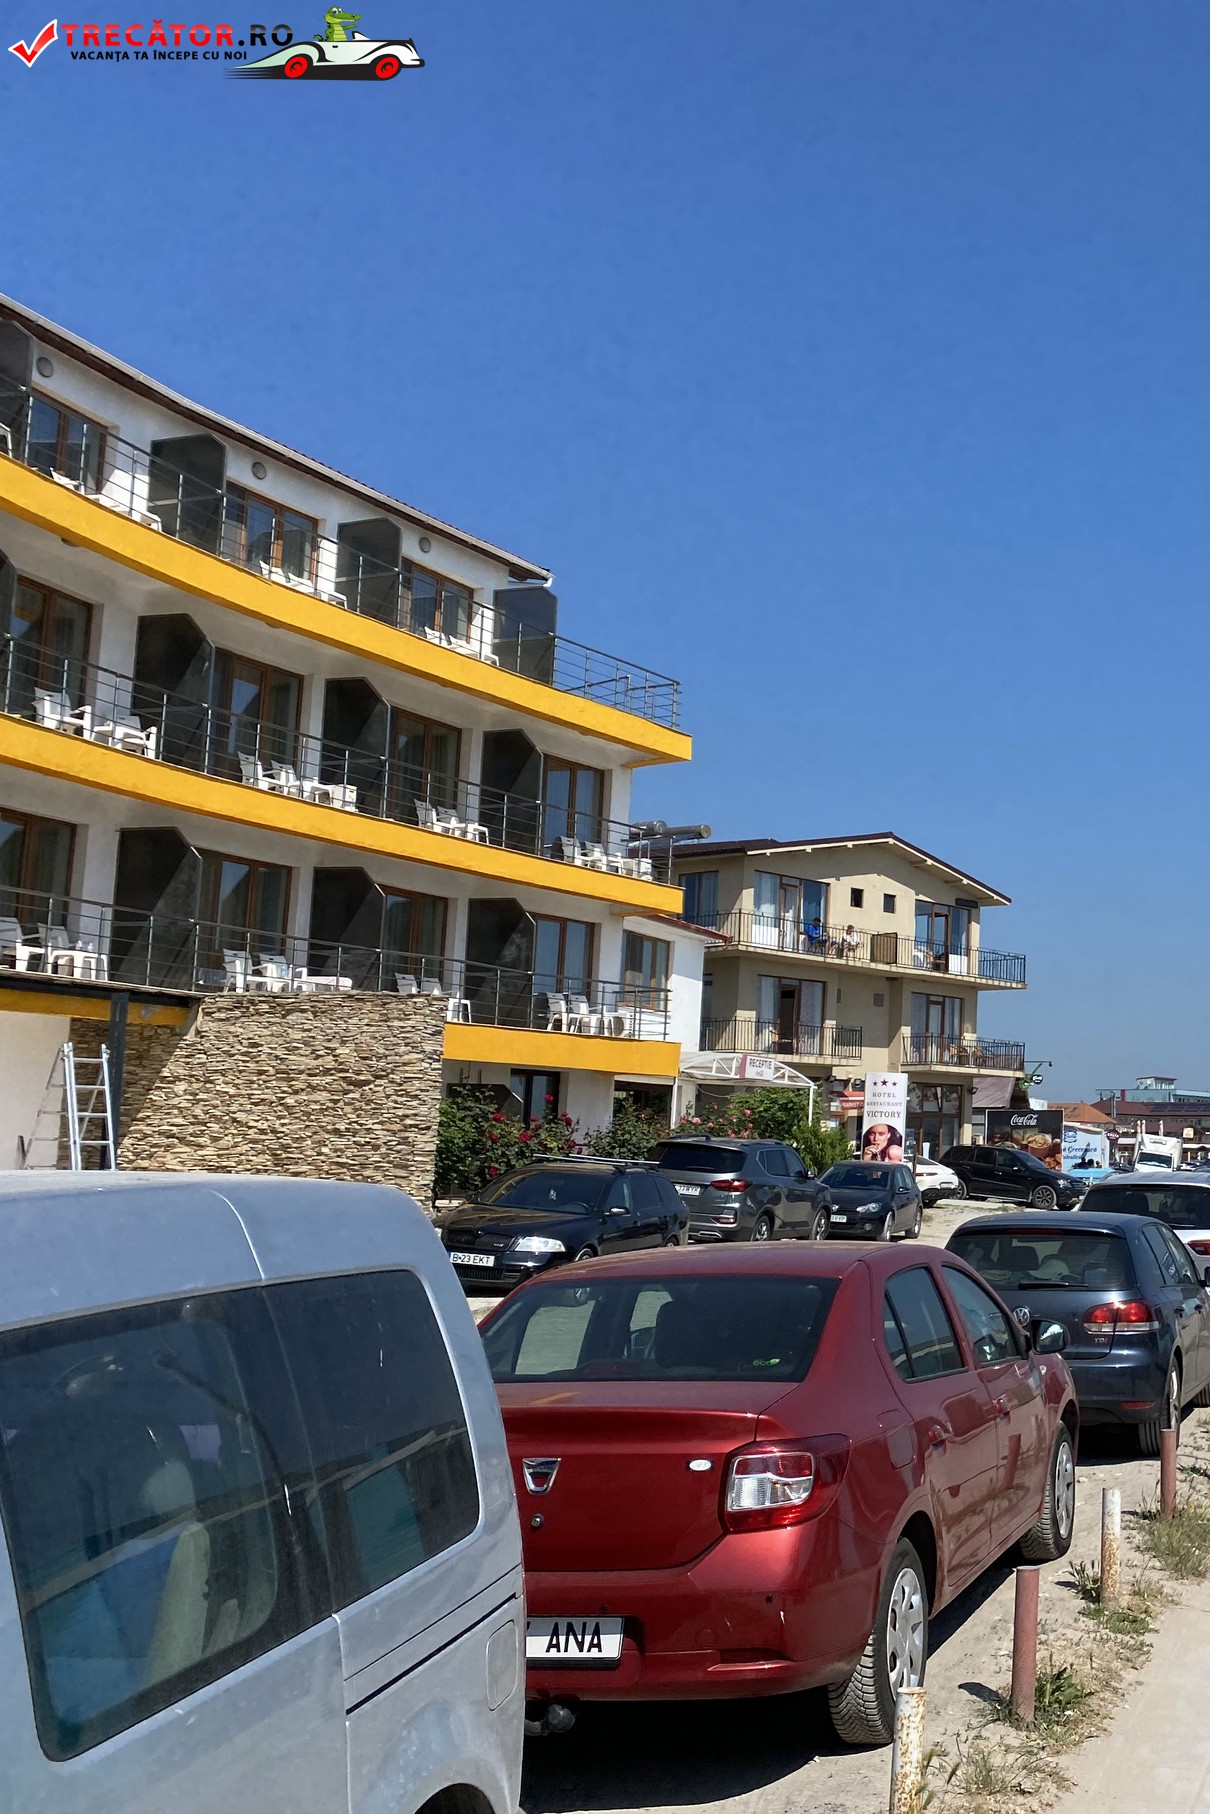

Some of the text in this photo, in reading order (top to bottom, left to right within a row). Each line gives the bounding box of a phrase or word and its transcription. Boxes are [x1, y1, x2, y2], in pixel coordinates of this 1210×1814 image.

[866, 1110, 901, 1118] VICTORY
[472, 1255, 490, 1264] EKT
[545, 1621, 602, 1653] ANA
